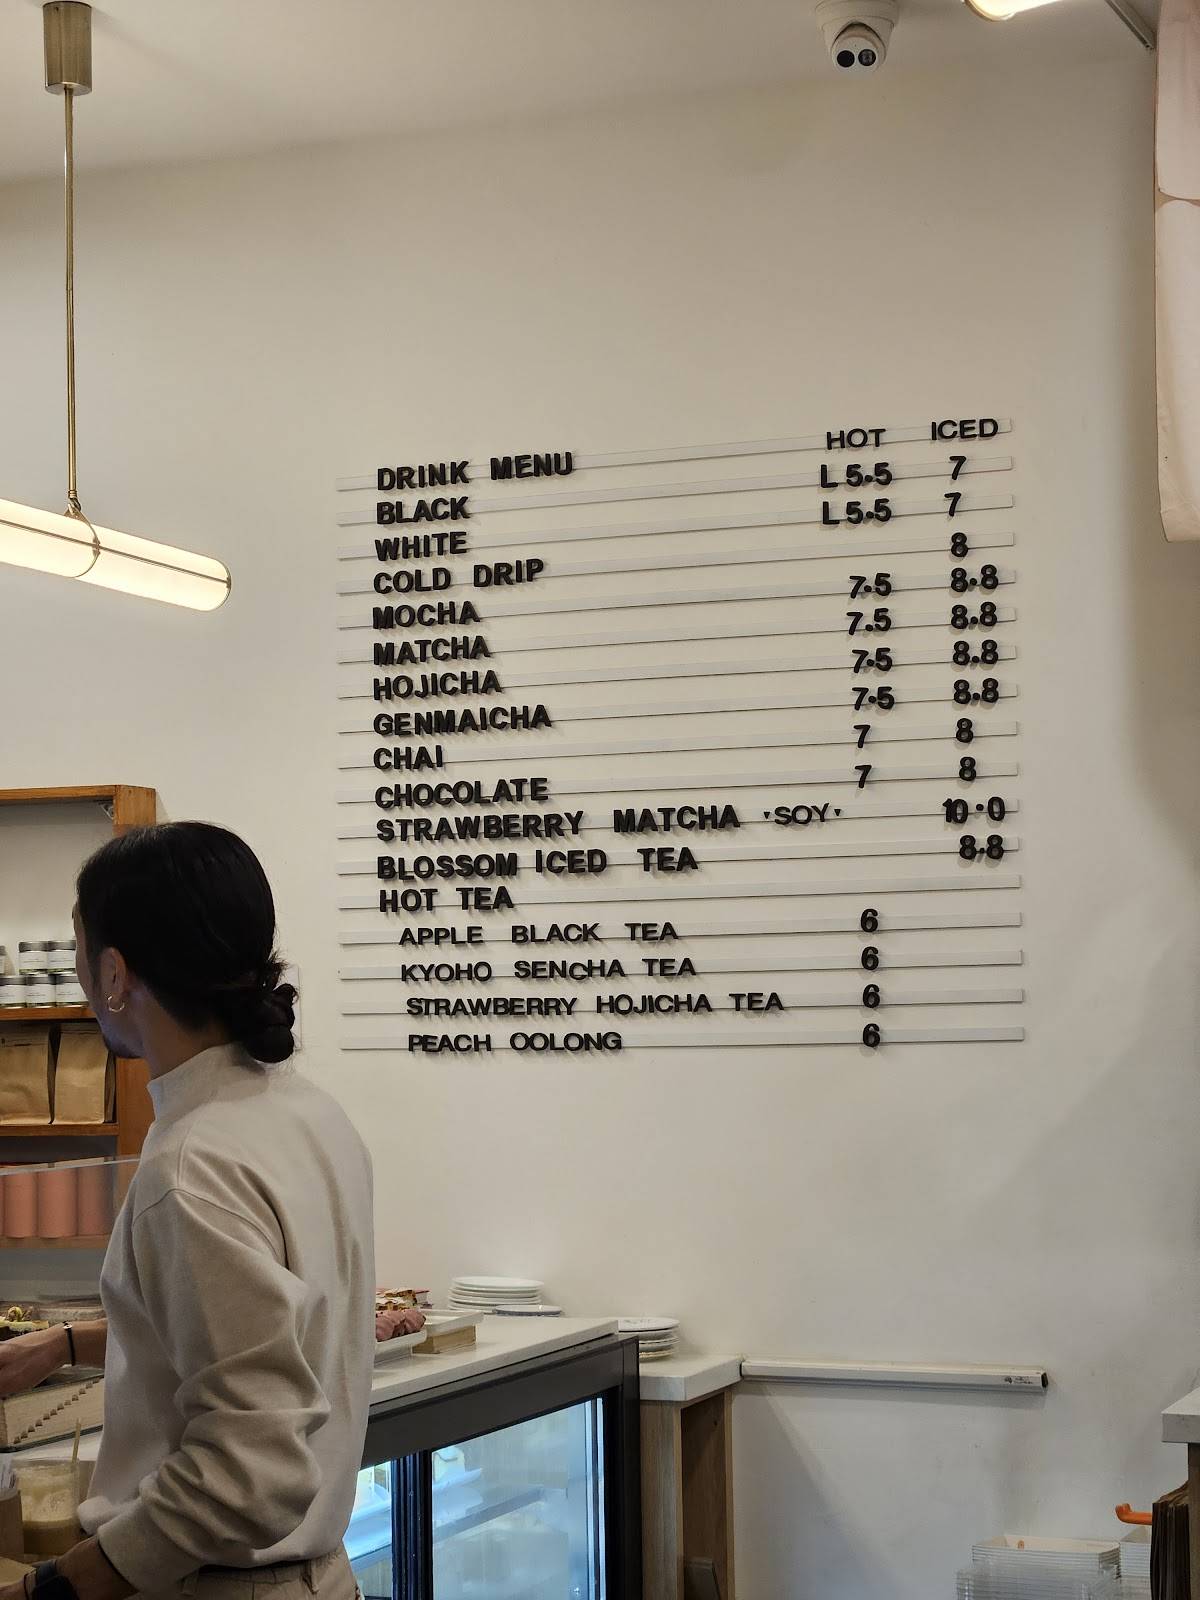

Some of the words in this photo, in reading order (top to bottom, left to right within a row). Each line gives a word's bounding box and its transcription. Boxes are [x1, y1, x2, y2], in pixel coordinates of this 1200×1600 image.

[826, 428, 886, 450] HOT
[931, 419, 998, 440] ICED
[377, 461, 469, 490] DRINK
[490, 452, 573, 480] MENU
[820, 465, 838, 488] L
[950, 456, 966, 480] 7
[376, 497, 470, 524] BLACK
[822, 501, 839, 525] L
[944, 492, 961, 516] 7
[375, 532, 467, 561] WHITE
[951, 532, 968, 557] 8
[373, 567, 451, 594] COLD
[473, 559, 544, 587] DRIP
[372, 601, 480, 629] MOCHA
[373, 636, 491, 665] MATCHA
[373, 670, 501, 700] HOJICHA
[373, 705, 551, 736] GENMAICHA
[956, 718, 974, 743] 8
[854, 725, 870, 748] 7
[373, 745, 443, 769] CHAI
[959, 756, 976, 781] 8
[855, 765, 872, 788] 7
[375, 778, 548, 808] CHOCOLATE
[376, 811, 584, 841] STRAWBERRY
[613, 805, 740, 832] MATCHA
[377, 853, 517, 880] BLOSSOM
[535, 849, 607, 873] ICED
[637, 847, 698, 872] TEA
[379, 888, 438, 912] HOT
[456, 886, 513, 910] TEA
[860, 909, 878, 933] 6
[399, 926, 483, 945] APPLE
[511, 923, 600, 943] BLACK
[625, 922, 678, 941] TEA
[401, 962, 492, 982] KYOHO
[514, 960, 625, 980] SENCHA
[642, 958, 696, 977] TEA
[861, 947, 879, 970] 6
[407, 997, 577, 1016] STRAWBERRY
[596, 994, 712, 1014] HOJICHA
[729, 992, 784, 1011] TEA
[862, 984, 880, 1008] 6
[408, 1034, 491, 1052] PEACH
[510, 1032, 623, 1051] OOLONG
[862, 1023, 880, 1047] 6
